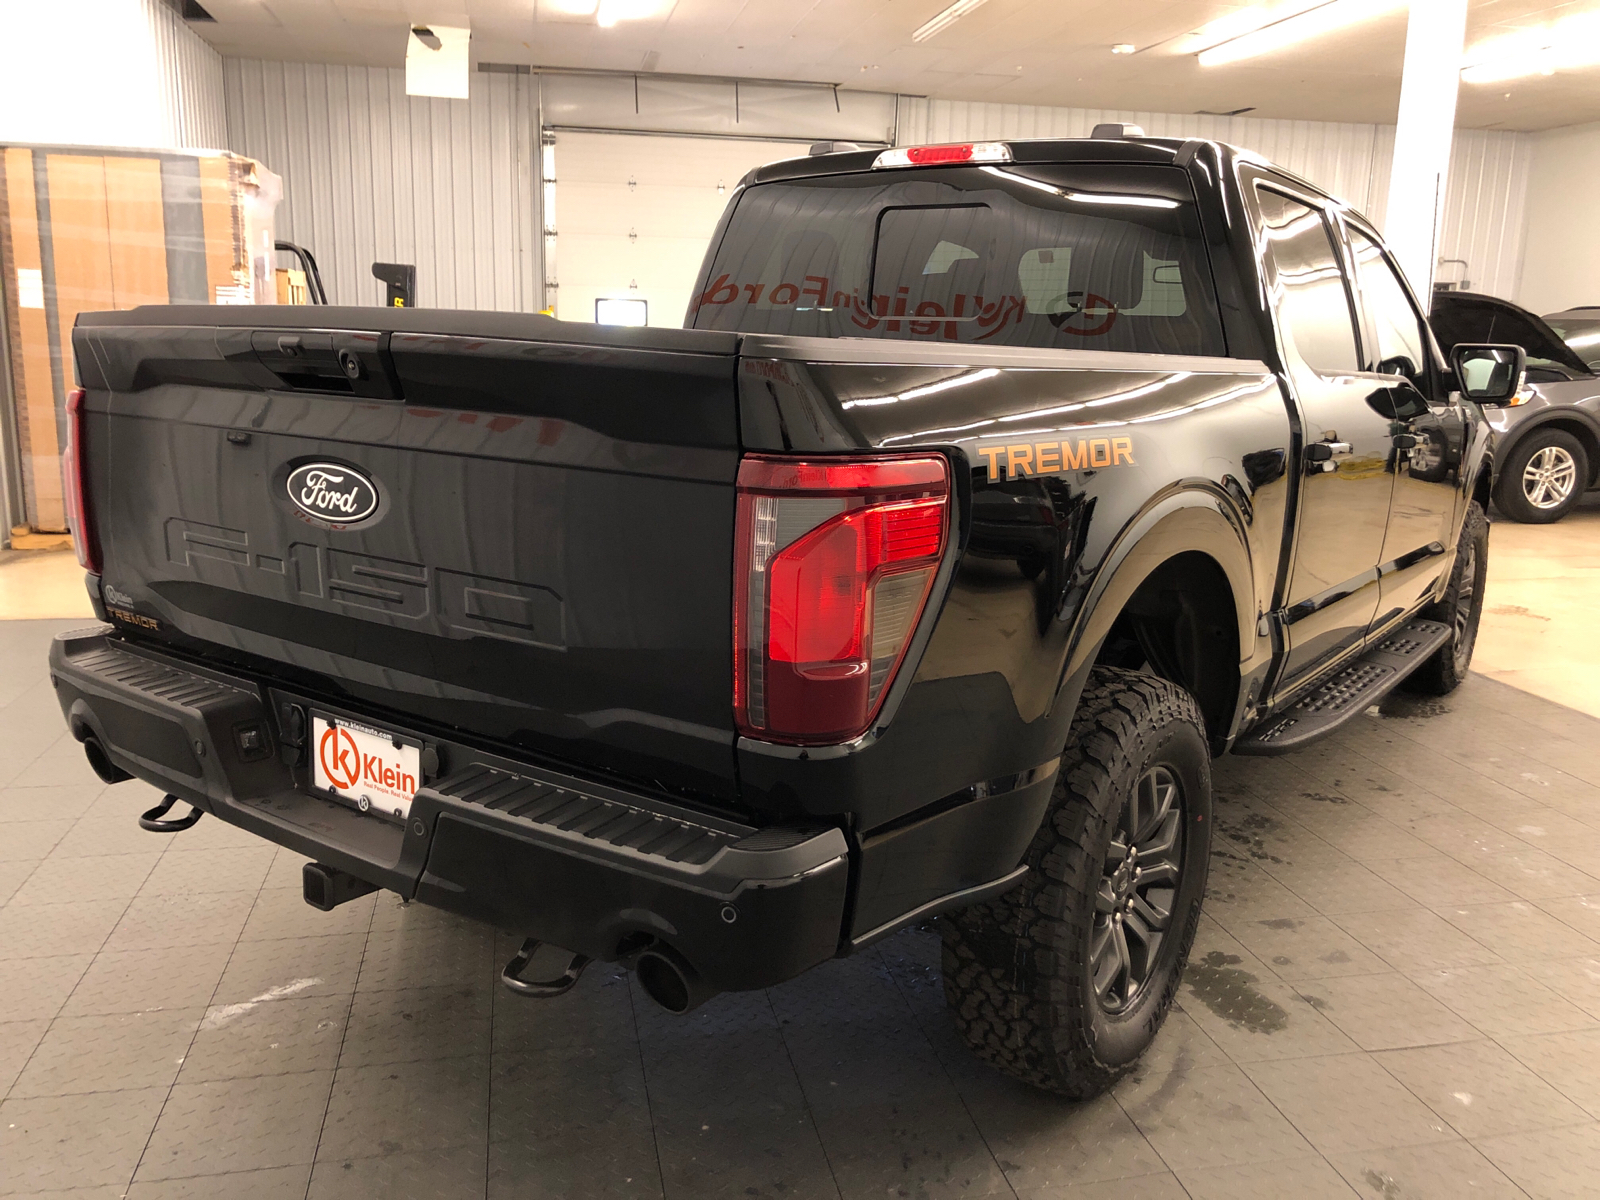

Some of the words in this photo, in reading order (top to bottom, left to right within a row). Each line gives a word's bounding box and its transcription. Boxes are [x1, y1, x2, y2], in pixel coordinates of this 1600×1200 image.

[978, 436, 1135, 480] TREMOR
[301, 470, 358, 513] Ford
[163, 516, 568, 652] F-150
[106, 606, 160, 631] TREMOR
[334, 718, 393, 741] www.kleinauto.com
[363, 752, 415, 795] Klein
